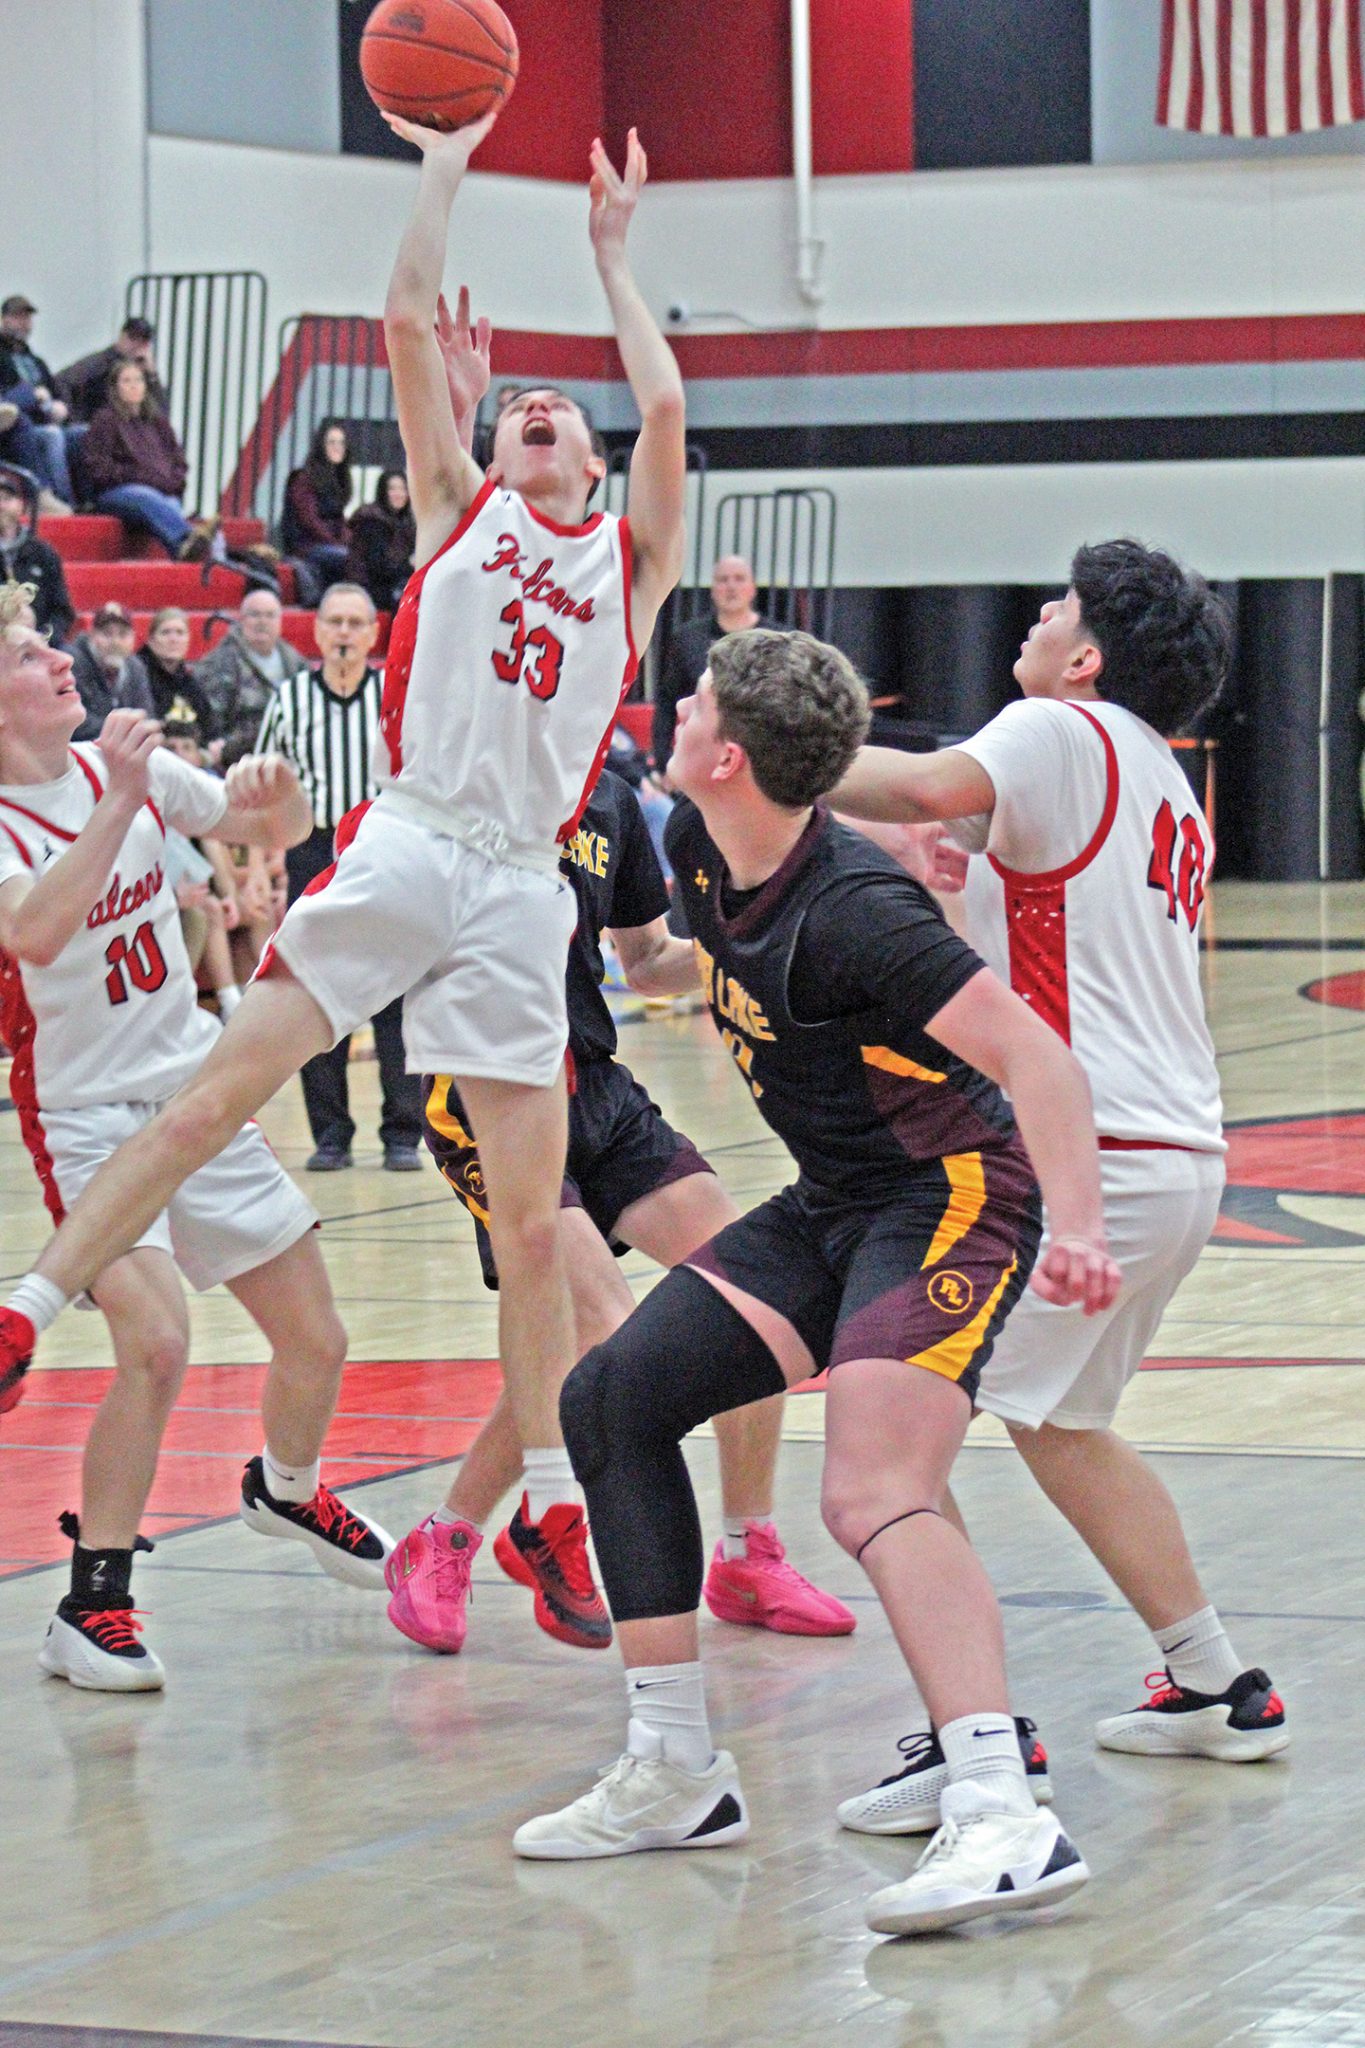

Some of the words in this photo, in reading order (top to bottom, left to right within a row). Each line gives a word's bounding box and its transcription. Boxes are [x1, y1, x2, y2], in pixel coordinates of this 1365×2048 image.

[491, 599, 564, 703] 33
[1147, 796, 1205, 933] 40
[105, 920, 168, 1006] 10
[717, 968, 777, 1041] LAKE
